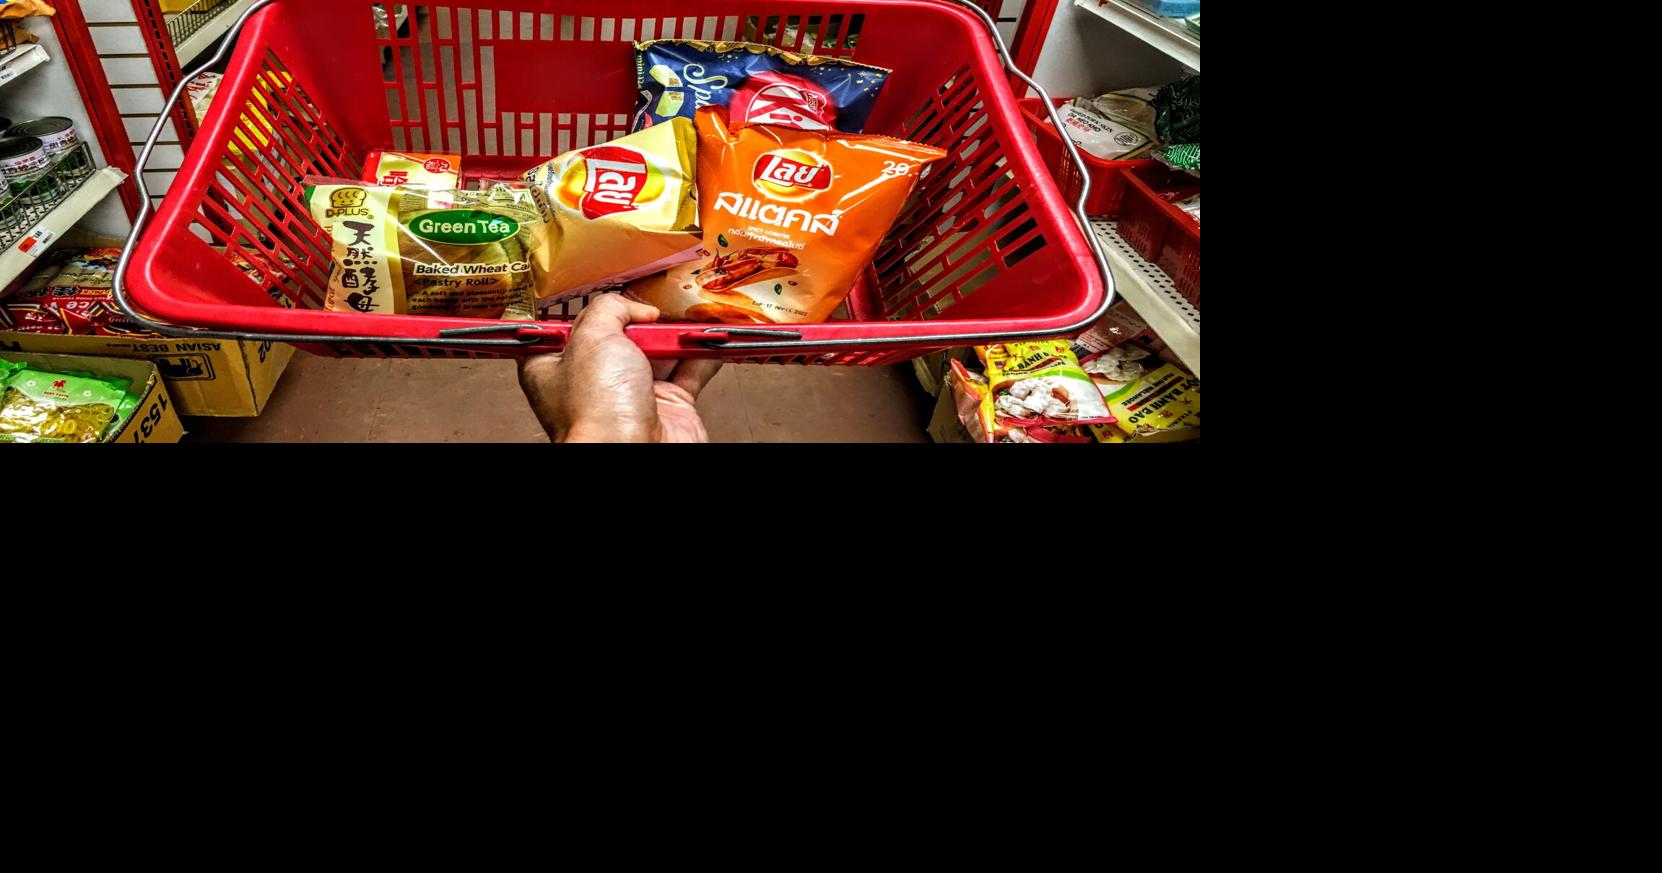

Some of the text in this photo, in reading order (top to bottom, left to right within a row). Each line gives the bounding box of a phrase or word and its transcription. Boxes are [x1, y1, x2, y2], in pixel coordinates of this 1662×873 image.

[418, 219, 511, 234] Green Tea
[415, 264, 459, 274] Baked
[463, 263, 508, 274] Wheat
[132, 343, 168, 352] BEST
[175, 342, 221, 352] ASIAN
